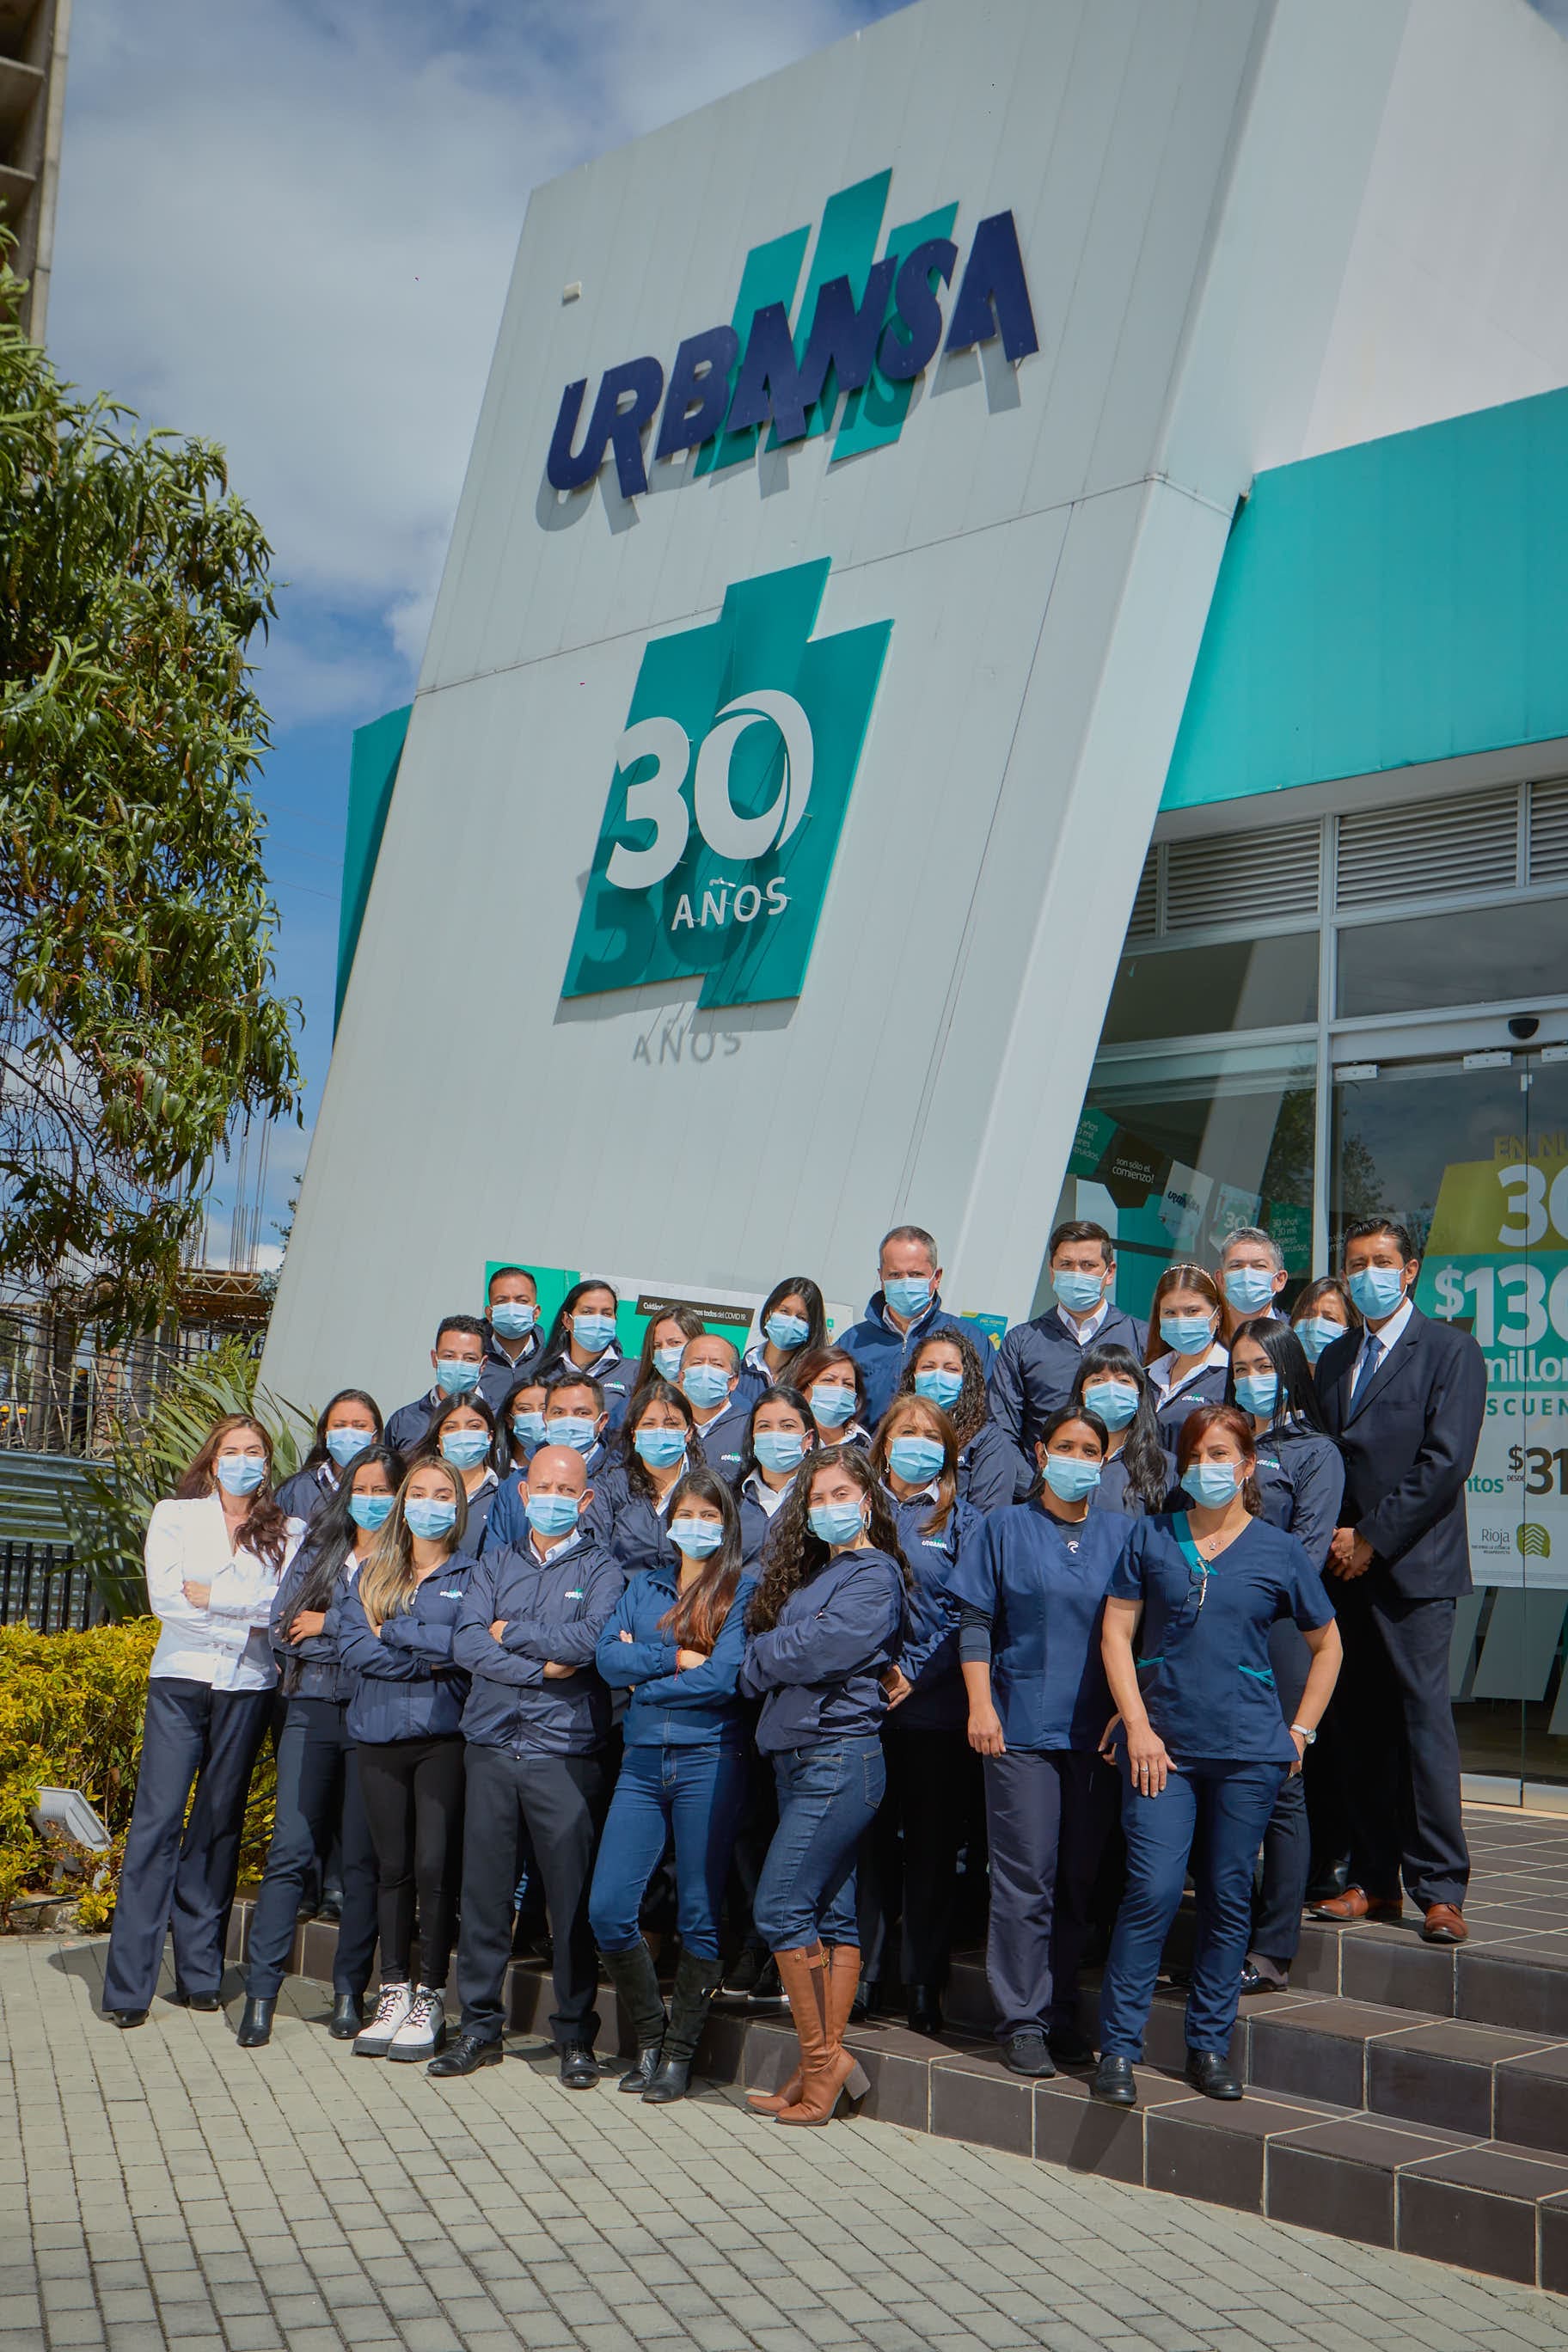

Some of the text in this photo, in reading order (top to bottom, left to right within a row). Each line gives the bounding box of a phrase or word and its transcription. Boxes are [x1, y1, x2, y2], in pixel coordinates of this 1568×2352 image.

[547, 210, 1038, 499] URBANSA
[605, 689, 814, 890] 30
[671, 876, 789, 930] AÑOS
[1494, 1135, 1527, 1160] EN
[1112, 1166, 1155, 1184] comienzo!
[1116, 1158, 1128, 1167] son
[1143, 1165, 1151, 1173] el
[1485, 1350, 1568, 1383] millo
[1486, 1398, 1568, 1417] SCUEN
[1481, 1528, 1510, 1546] Rioja
